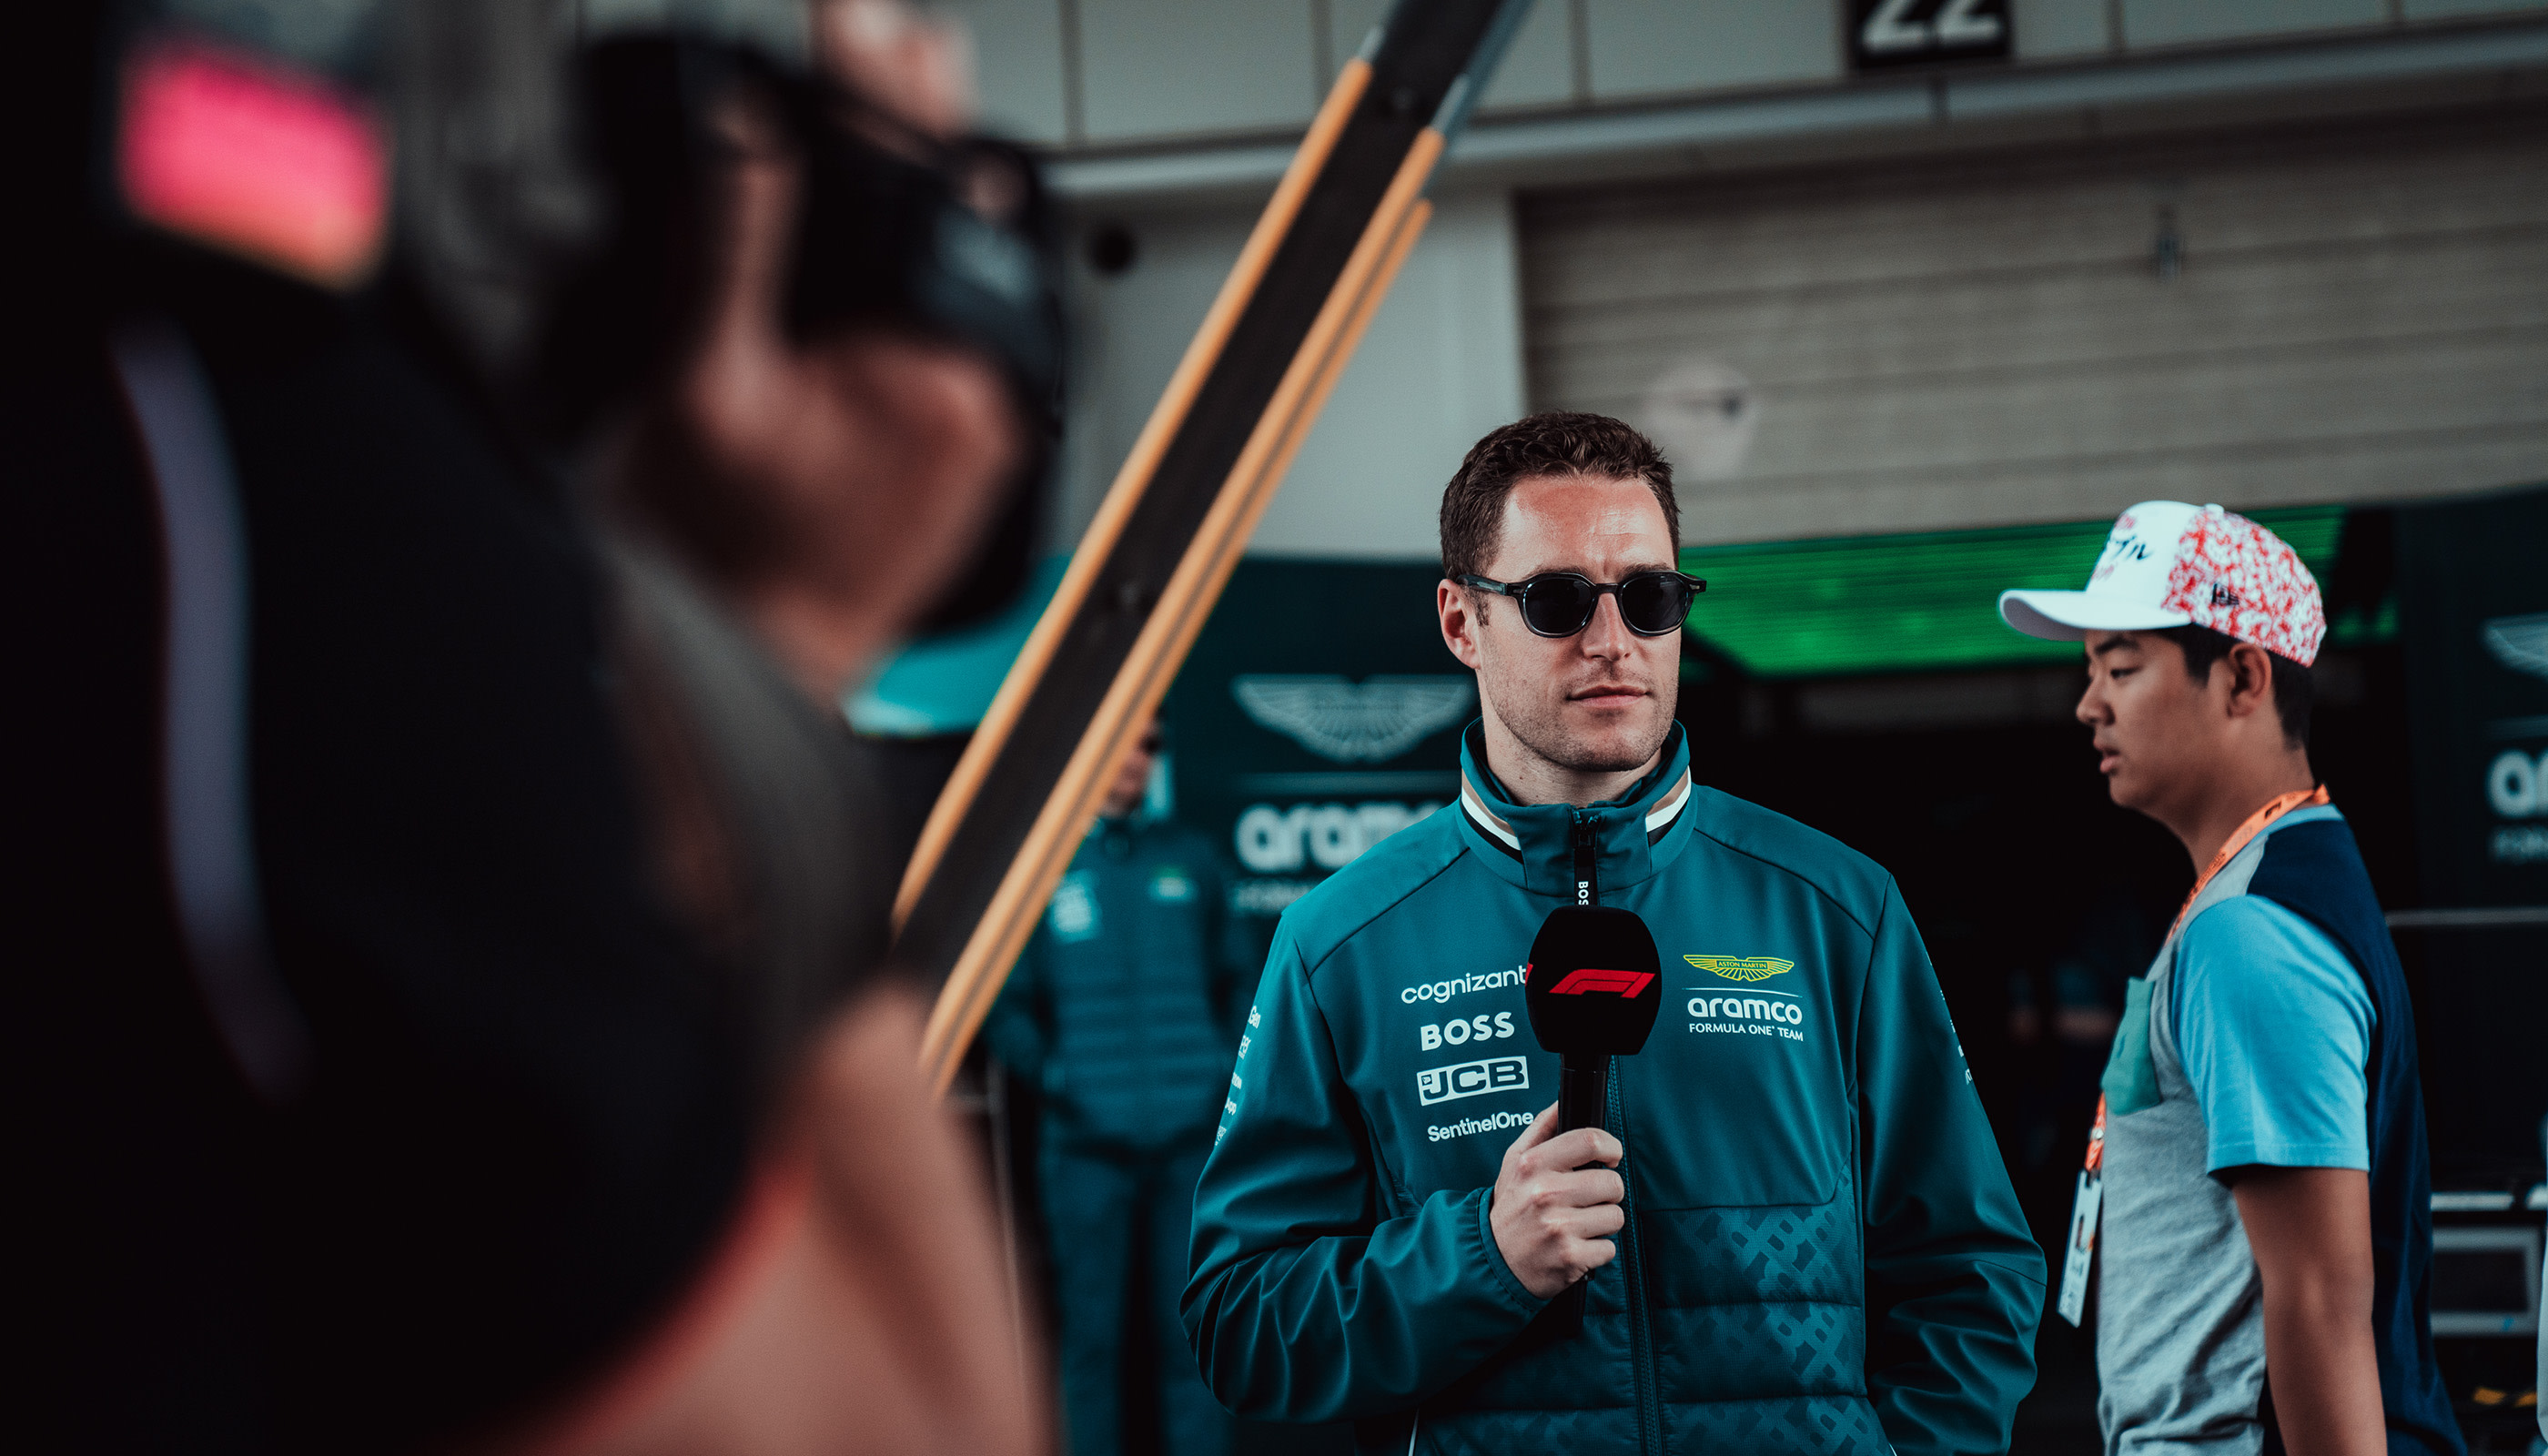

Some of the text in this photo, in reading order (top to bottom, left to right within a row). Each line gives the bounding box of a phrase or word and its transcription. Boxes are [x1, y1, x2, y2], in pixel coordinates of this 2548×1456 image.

[1400, 965, 1527, 1004] cognizant
[1549, 968, 1656, 999] F1
[1687, 997, 1803, 1026] aramco
[1420, 1011, 1515, 1052] BOSS
[1689, 1023, 1746, 1034] FORMULA
[1776, 1026, 1804, 1042] TEAM
[1422, 1060, 1525, 1100] JCB
[1427, 1111, 1534, 1142] SentinelOne
